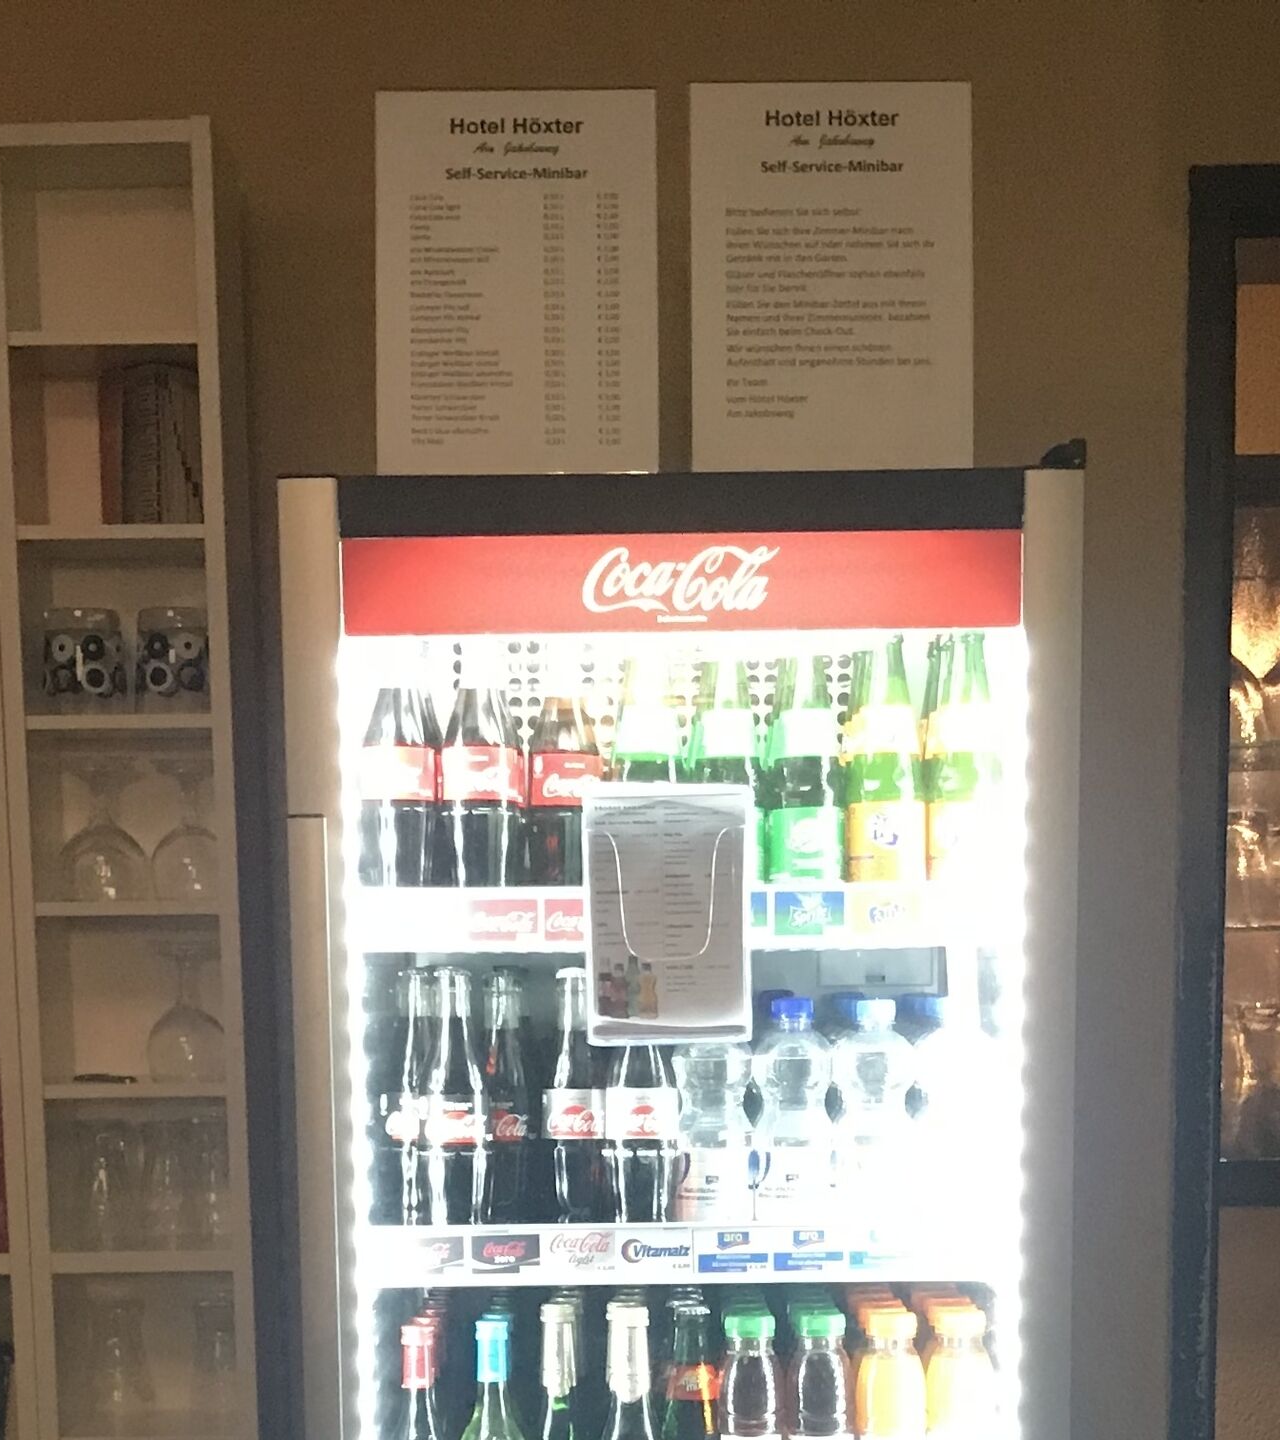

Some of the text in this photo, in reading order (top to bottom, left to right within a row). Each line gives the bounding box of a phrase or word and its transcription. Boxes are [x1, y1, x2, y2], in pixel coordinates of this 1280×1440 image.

[449, 116, 585, 135] Hotel Höxter
[764, 108, 900, 127] Hotel Höxter
[444, 166, 589, 181] Self-Service-Minibar
[760, 159, 905, 174] Self-Service-Minibar
[581, 545, 781, 614] Coca-Cola
[494, 1113, 529, 1138] Cola
[549, 1230, 612, 1254] Coca-Cola
[633, 1243, 691, 1259] Vitamalz
